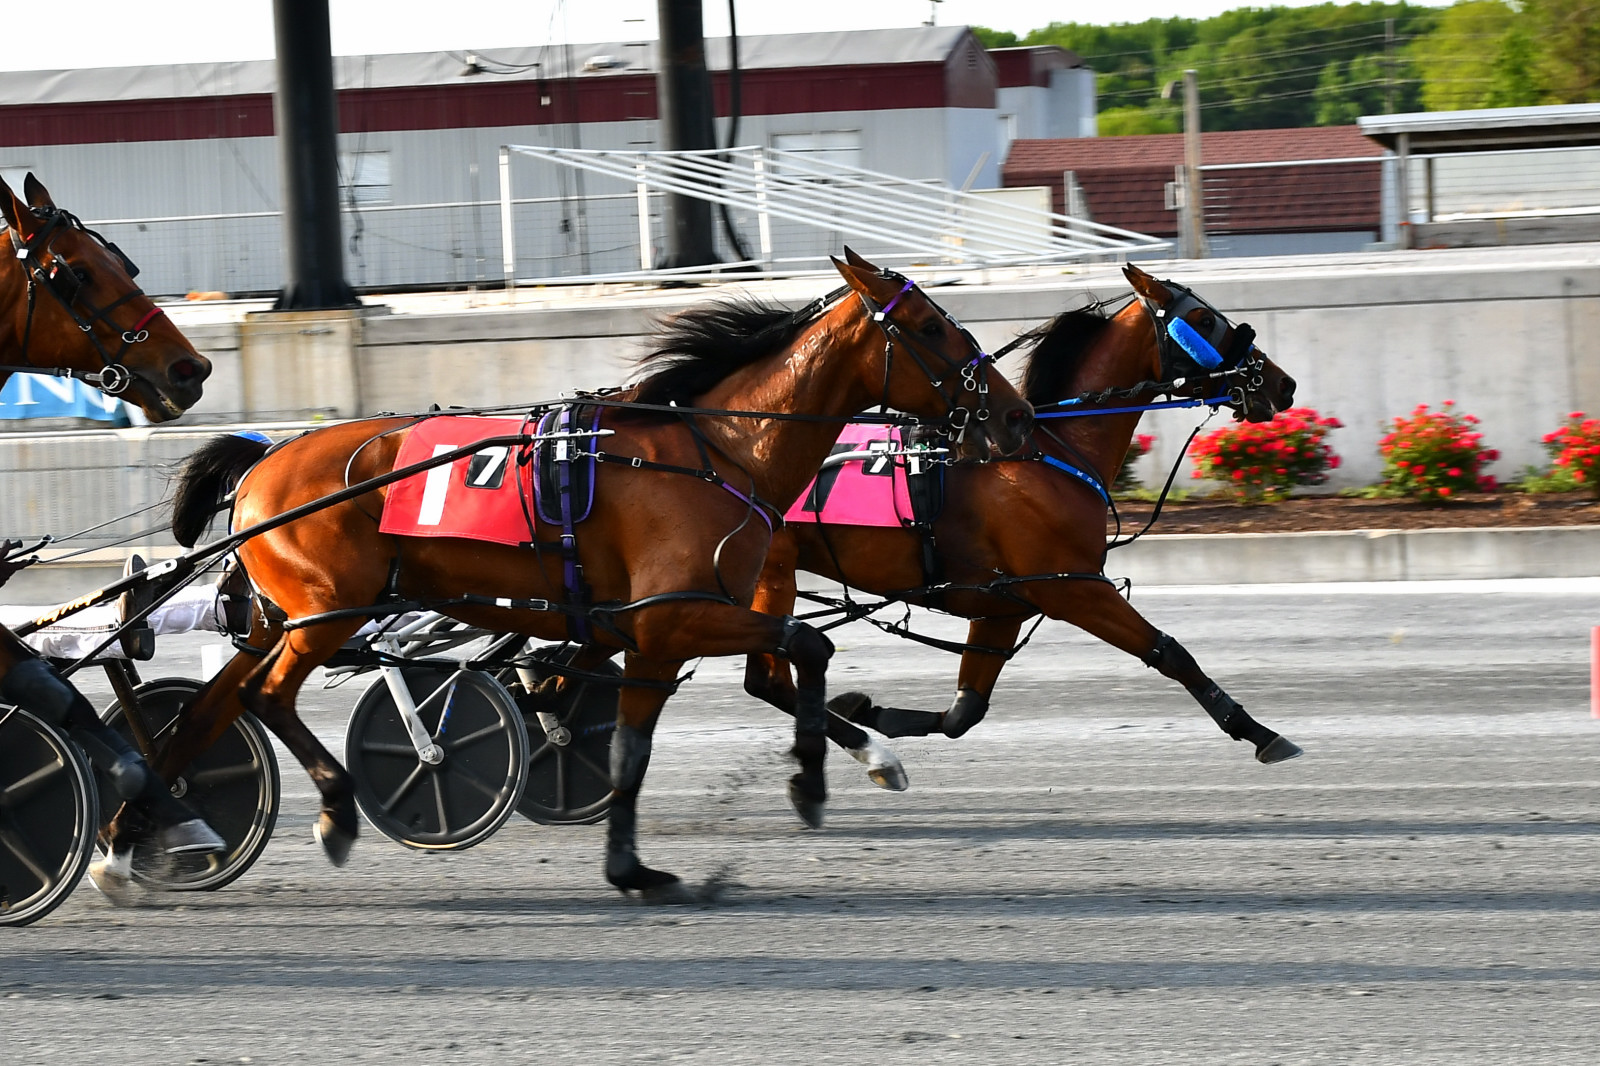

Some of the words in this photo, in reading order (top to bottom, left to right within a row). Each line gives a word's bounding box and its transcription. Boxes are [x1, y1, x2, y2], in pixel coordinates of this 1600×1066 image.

[472, 446, 509, 485] 7
[869, 442, 897, 473] 7
[417, 444, 458, 525] 1
